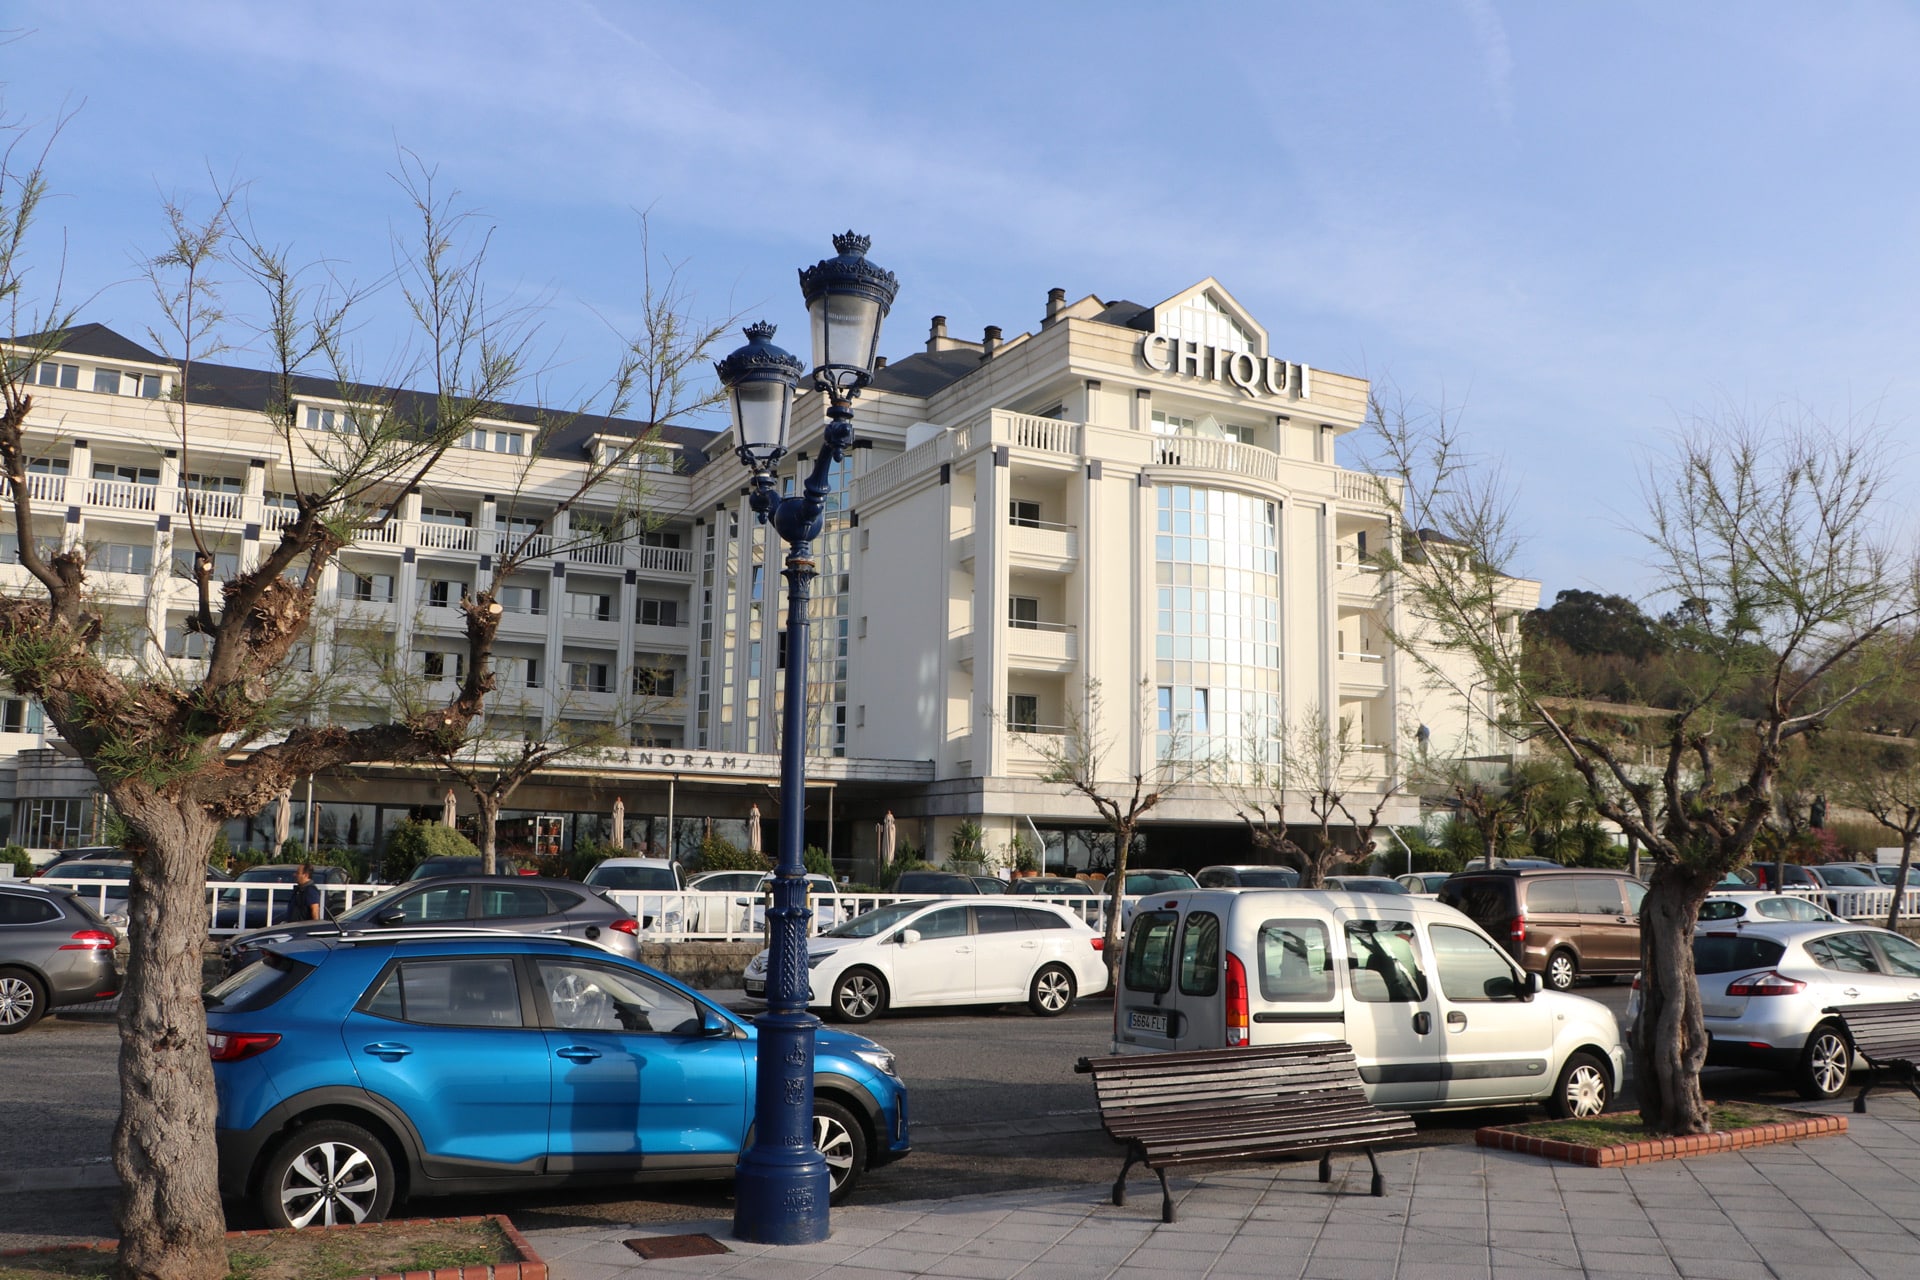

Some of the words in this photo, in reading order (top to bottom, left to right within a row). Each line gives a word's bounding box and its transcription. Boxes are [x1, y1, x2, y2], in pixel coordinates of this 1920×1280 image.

[1143, 332, 1310, 399] CHIQUI
[1132, 1014, 1149, 1028] 5664
[1151, 1016, 1166, 1030] FLT
